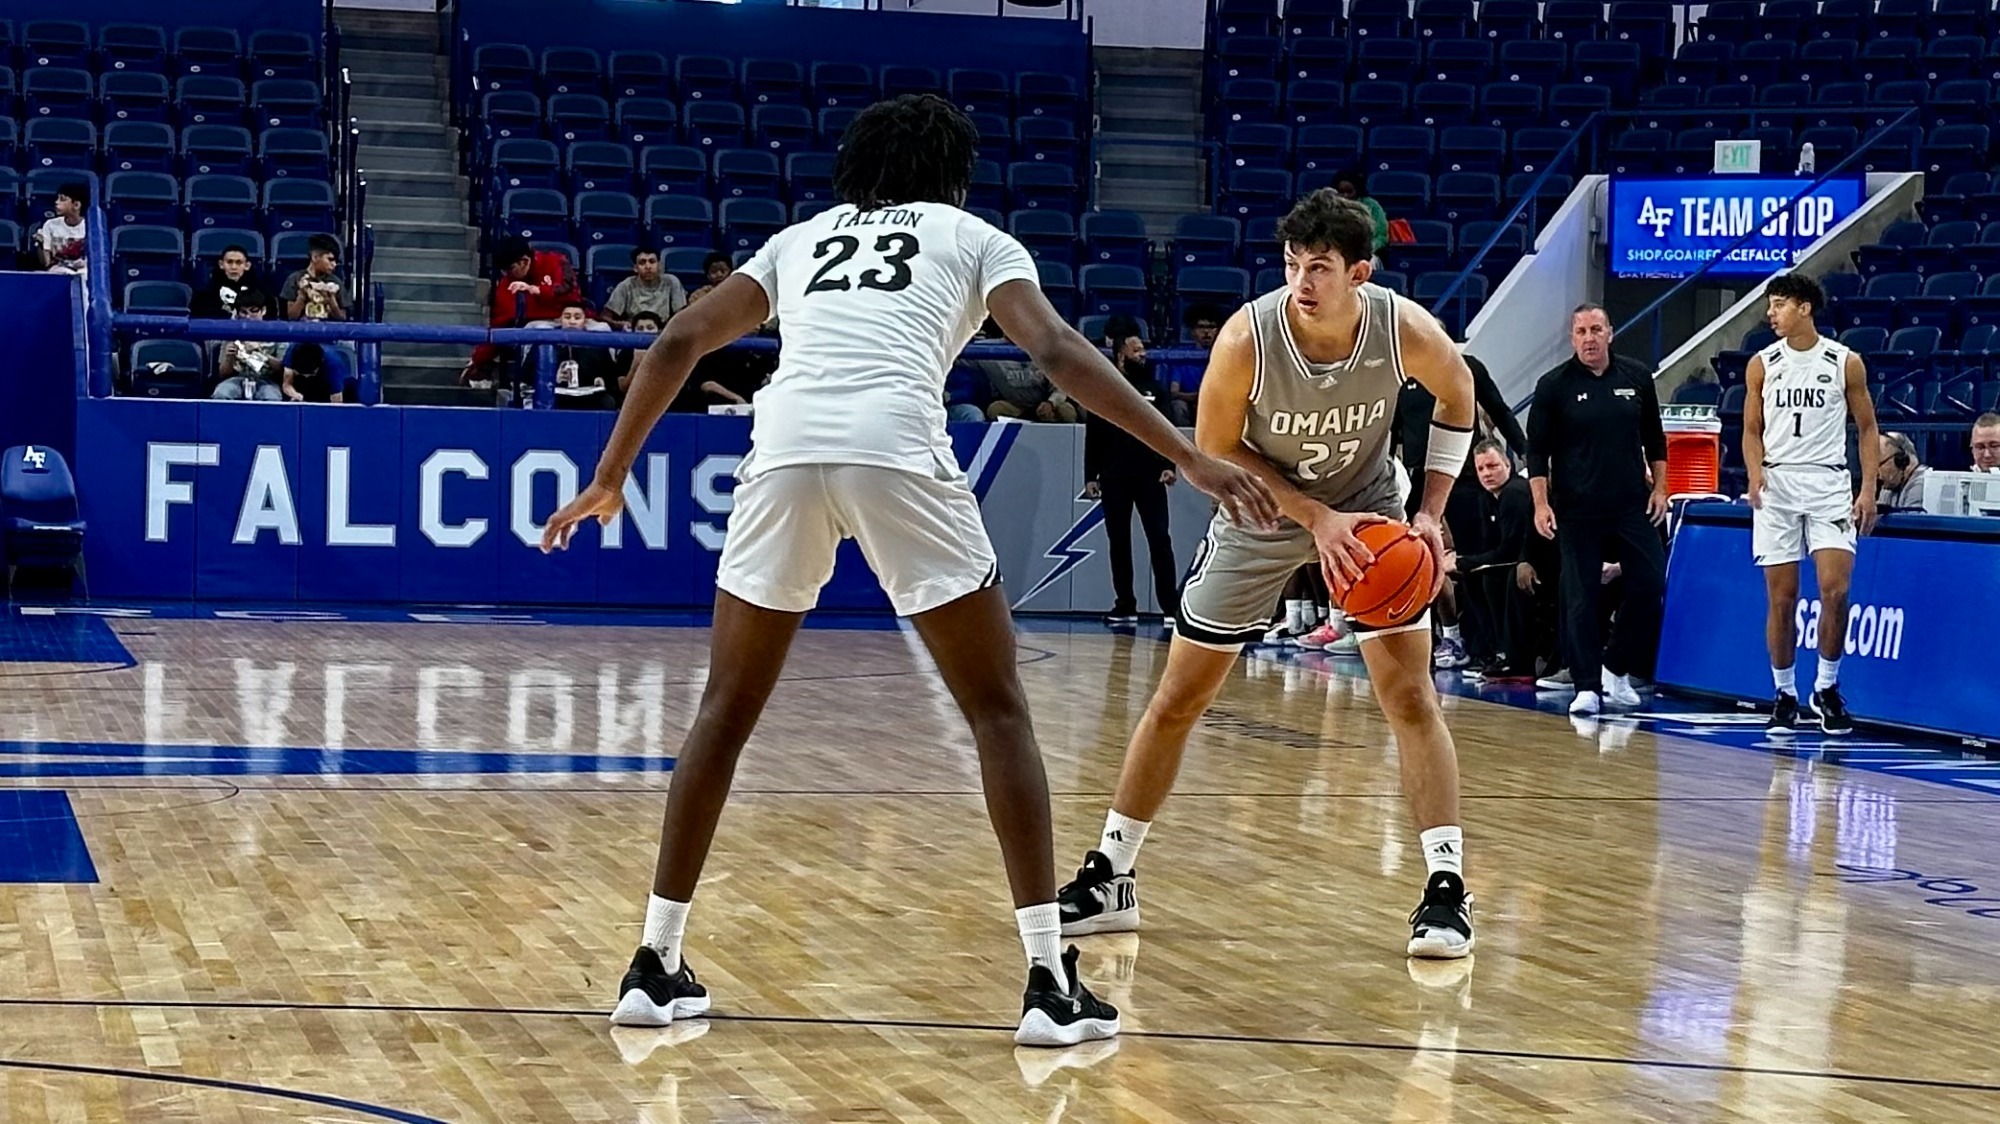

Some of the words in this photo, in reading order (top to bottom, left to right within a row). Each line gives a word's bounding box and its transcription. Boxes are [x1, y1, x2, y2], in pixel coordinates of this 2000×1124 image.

[1721, 144, 1752, 168] EXIT
[832, 208, 924, 231] TALTON
[1637, 196, 1674, 238] AF
[1681, 196, 1753, 237] TEAM
[1761, 195, 1835, 237] SHOP
[804, 232, 921, 297] 23
[1775, 387, 1826, 408] LIONS
[1270, 398, 1387, 436] OMAHA
[1793, 411, 1803, 438] 1
[23, 445, 46, 469] AF
[1297, 438, 1362, 481] 23
[145, 442, 743, 551] FALCONS
